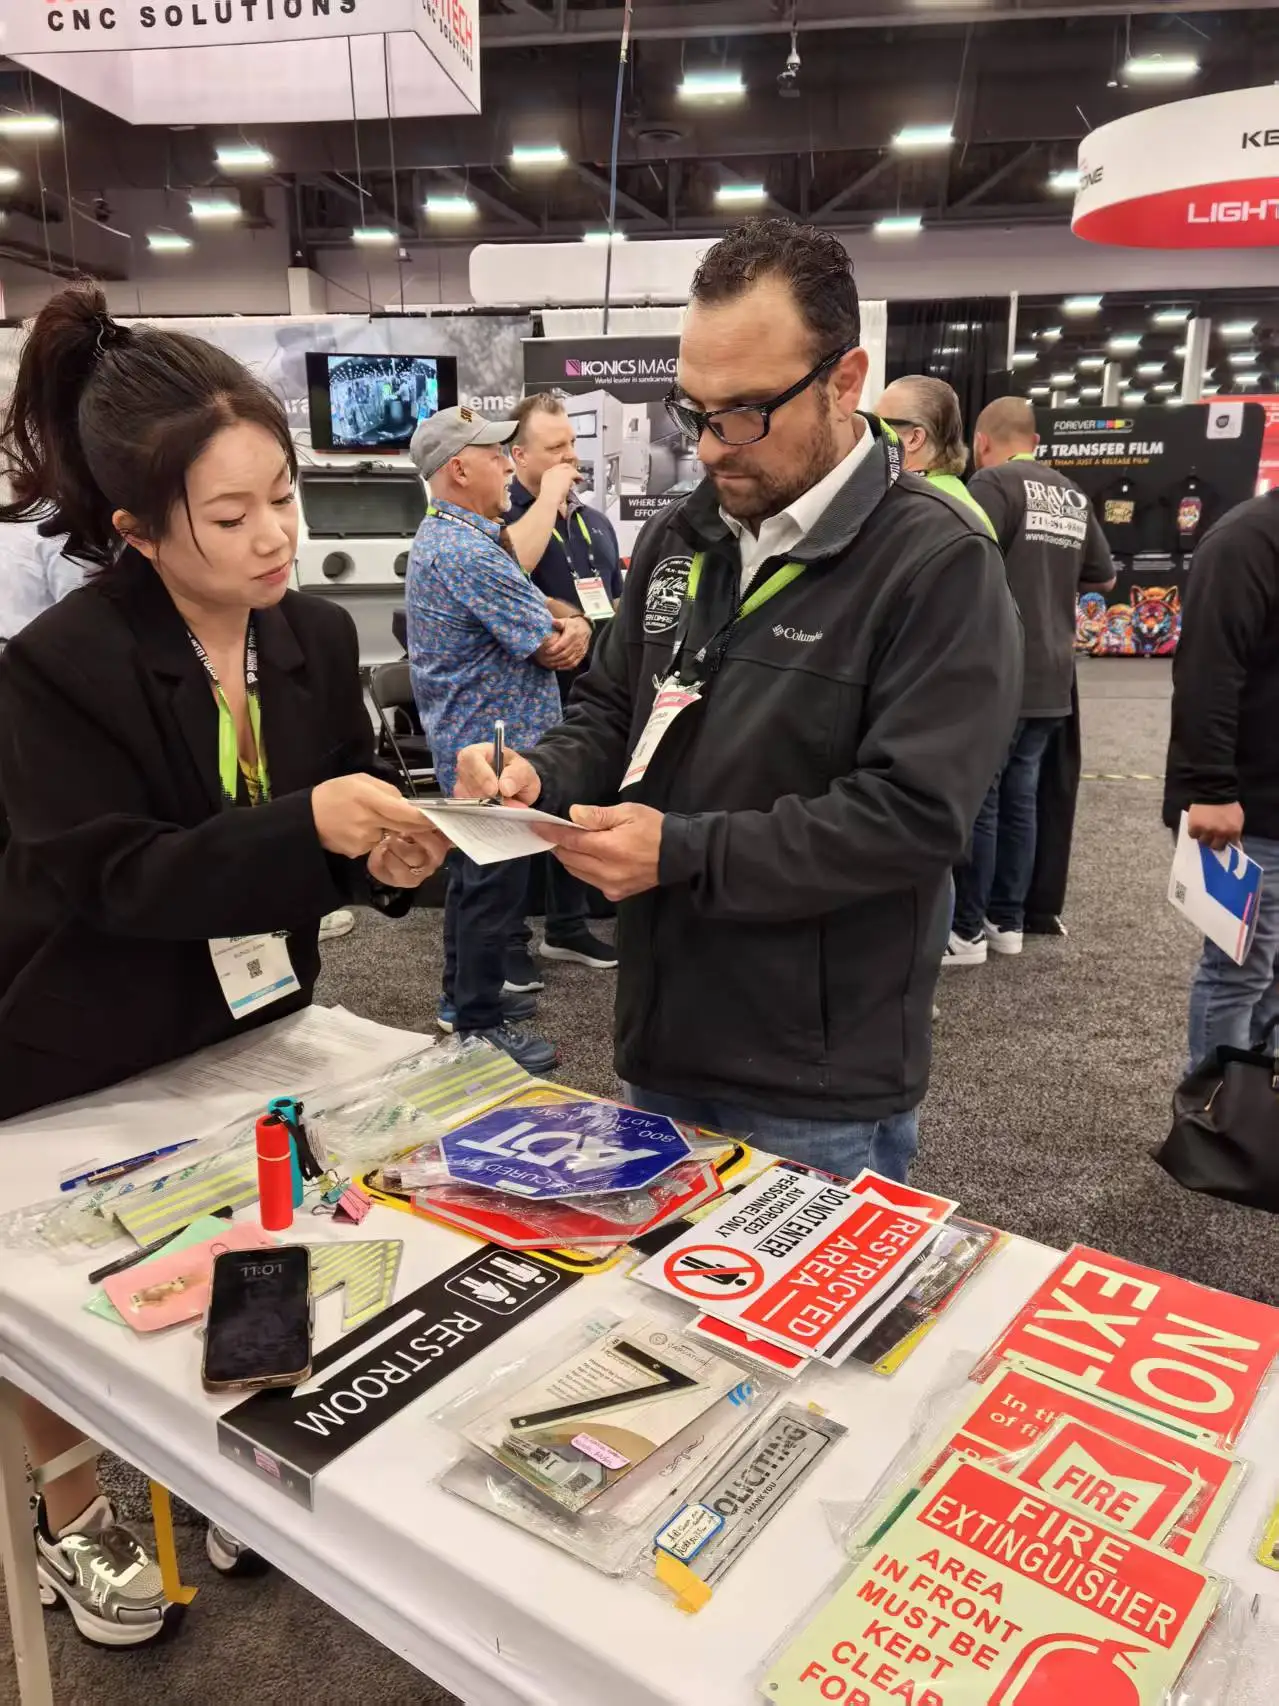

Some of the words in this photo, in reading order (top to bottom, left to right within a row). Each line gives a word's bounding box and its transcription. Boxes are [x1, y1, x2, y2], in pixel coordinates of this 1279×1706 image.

[47, 8, 117, 31] CNC
[140, 0, 357, 28] SOLUTIONS
[1079, 166, 1104, 191] ONE
[581, 359, 635, 376] IKONICS
[1053, 419, 1096, 431] FOREVER
[1051, 442, 1125, 457] TRANSFER
[1128, 441, 1165, 455] FILM
[628, 498, 656, 507] WHERE
[1023, 479, 1088, 510] BRAVO
[455, 1121, 663, 1174] ADT
[739, 1174, 800, 1216] PERSONNEL
[743, 1187, 806, 1235] AUTHORIZED
[821, 1187, 851, 1207] DO
[715, 1215, 747, 1238] ONLY
[793, 1201, 836, 1232] NOT
[758, 1221, 813, 1259] ENTER
[240, 1263, 283, 1277] 11:01
[788, 1235, 859, 1288] AREA
[788, 1217, 921, 1337] RESTRICTED
[1002, 1260, 1161, 1387] EXIT
[293, 1311, 484, 1437] RESTROOM
[1129, 1312, 1262, 1414] NO
[1000, 1392, 1028, 1413] In
[989, 1412, 1018, 1428] of
[1020, 1423, 1041, 1439] fi
[713, 1424, 808, 1517] OLICITING
[743, 1493, 766, 1517] THANK
[762, 1481, 778, 1499] YOU
[1053, 1464, 1141, 1525] FIRE
[1006, 1496, 1131, 1575] FIRE
[916, 1548, 1005, 1605] AREA
[923, 1495, 1179, 1642] EXTINGUISHER
[872, 1553, 910, 1584] IN
[908, 1573, 1024, 1644] FRONT
[856, 1579, 951, 1640] MUST
[948, 1631, 1001, 1672] BE
[862, 1618, 955, 1680] KEPT
